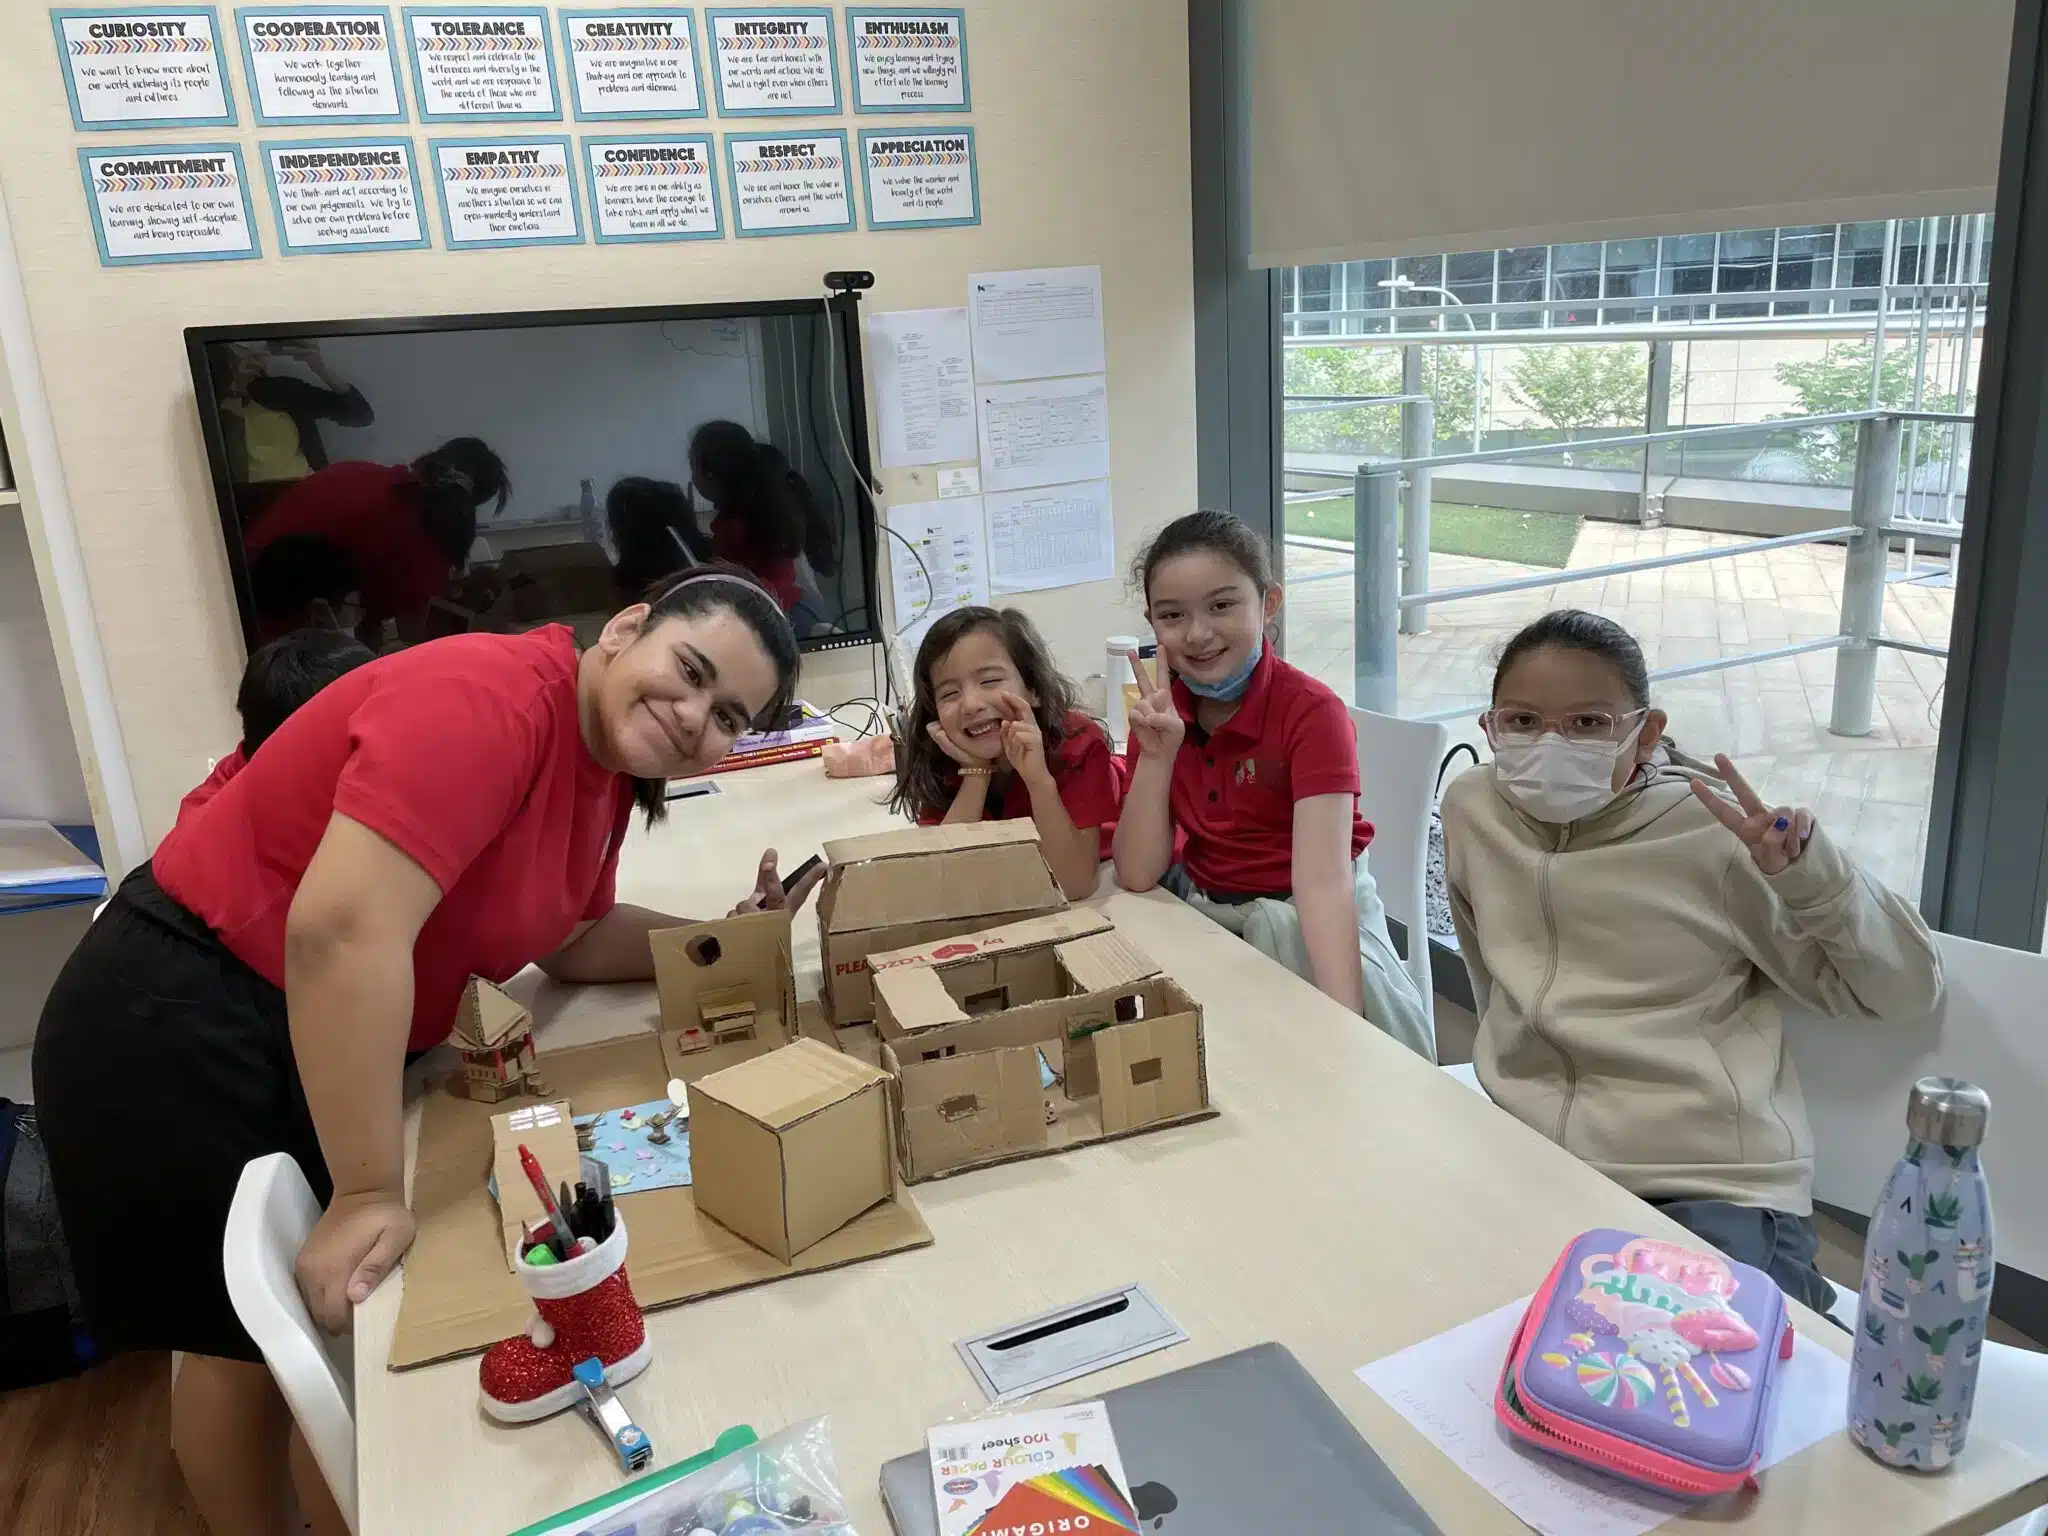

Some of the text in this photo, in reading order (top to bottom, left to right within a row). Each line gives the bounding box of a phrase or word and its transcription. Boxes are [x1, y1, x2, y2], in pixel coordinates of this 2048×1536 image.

[89, 22, 186, 38] CURIOSITY
[253, 22, 380, 36] COOPERATION
[431, 22, 525, 35] TOLERANCE
[586, 23, 673, 36] CREATIVITY
[735, 22, 808, 35] INTEGRITY
[865, 22, 949, 34] ENTHUSIASM
[284, 58, 361, 70] We work together
[473, 64, 486, 72] and
[590, 59, 602, 67] We
[82, 63, 210, 76] We want to know more about
[170, 79, 181, 87] its
[184, 79, 209, 90] people
[329, 73, 376, 84] leading and
[455, 77, 468, 85] and
[278, 87, 314, 98] following
[329, 87, 342, 95] the
[345, 85, 378, 95] situation
[441, 89, 452, 98] the
[126, 94, 142, 102] and
[759, 144, 816, 158] RESPECT
[872, 140, 964, 154] APPRECIATION
[279, 152, 401, 169] INDEPENDENCE
[466, 150, 539, 165] EMPATHY
[605, 148, 695, 162] CONFIDENCE
[100, 159, 226, 177] COMMITMENT
[284, 184, 408, 198] We think and act according to
[606, 184, 618, 192] We
[620, 184, 632, 192] are
[286, 203, 298, 211] our
[370, 199, 384, 208] We
[387, 198, 400, 209] try
[404, 198, 411, 206] to
[656, 194, 668, 203] the
[109, 205, 124, 213] We
[127, 204, 141, 212] are
[144, 201, 188, 211] dedicated
[191, 201, 200, 209] to
[203, 201, 214, 209] our
[645, 207, 658, 216] and
[148, 216, 180, 227] showing
[292, 212, 410, 224] solve our own problems before
[134, 229, 174, 240] and being
[318, 226, 348, 237] seeking
[983, 938, 1004, 946] by
[982, 1433, 1050, 1451] 100 sheet
[992, 1450, 1054, 1468] COLOUR
